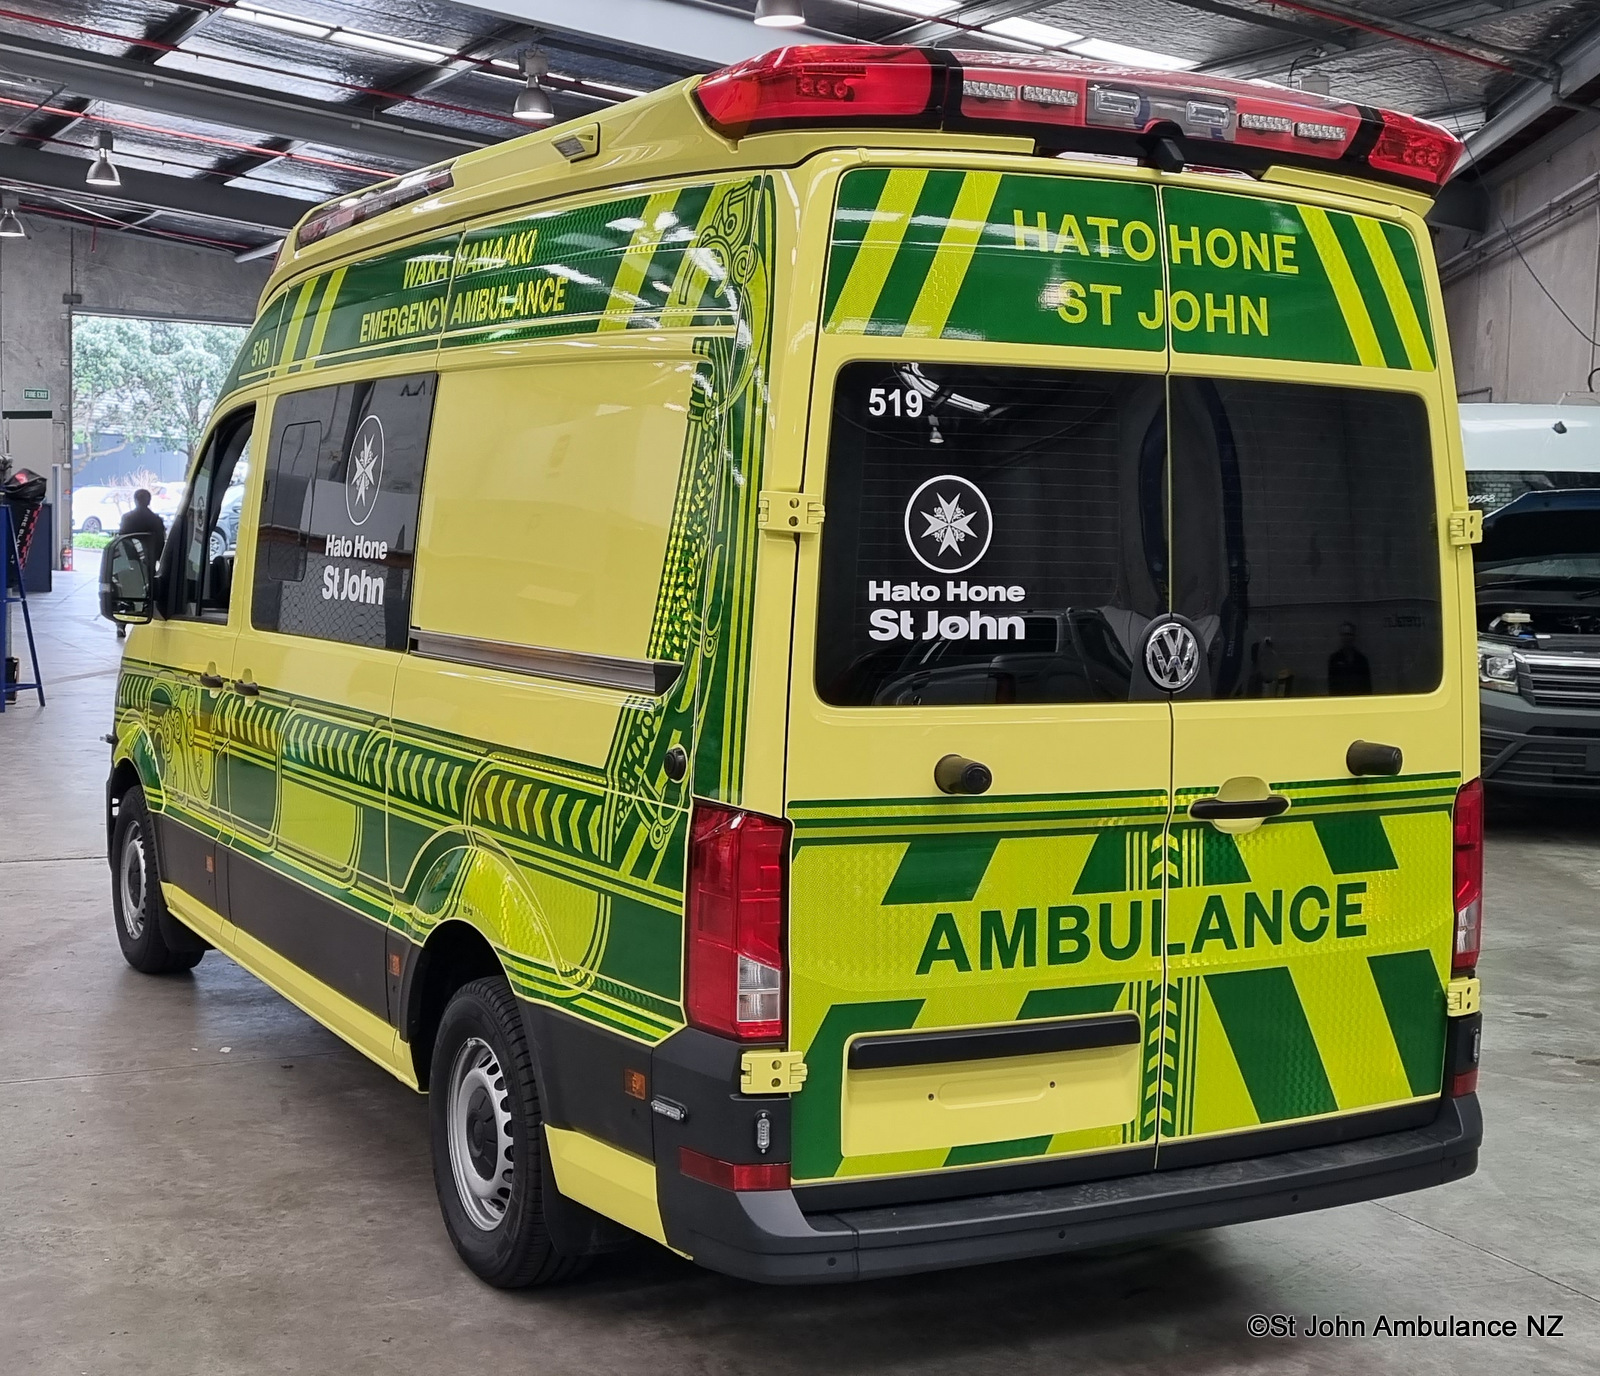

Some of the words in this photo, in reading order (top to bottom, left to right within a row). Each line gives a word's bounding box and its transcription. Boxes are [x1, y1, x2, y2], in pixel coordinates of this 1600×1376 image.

[403, 248, 450, 289] WAKA
[454, 228, 538, 276] MANAAKI
[1013, 209, 1156, 262] HATO
[1169, 224, 1300, 275] HONE
[359, 297, 447, 343] EMERGENCY
[450, 276, 568, 325] AMBULANCE
[1057, 280, 1122, 326] ST
[1138, 289, 1269, 337] JOHN
[251, 338, 270, 367] 519
[868, 388, 923, 418] 519
[325, 534, 352, 557] Hato
[353, 535, 388, 560] Hone
[322, 565, 340, 600] St
[340, 568, 384, 605] John
[868, 580, 941, 602] Hato
[946, 581, 1026, 602] Hone
[868, 608, 914, 641] St
[922, 610, 1026, 641] John
[915, 881, 1368, 975] AMBULANCE
